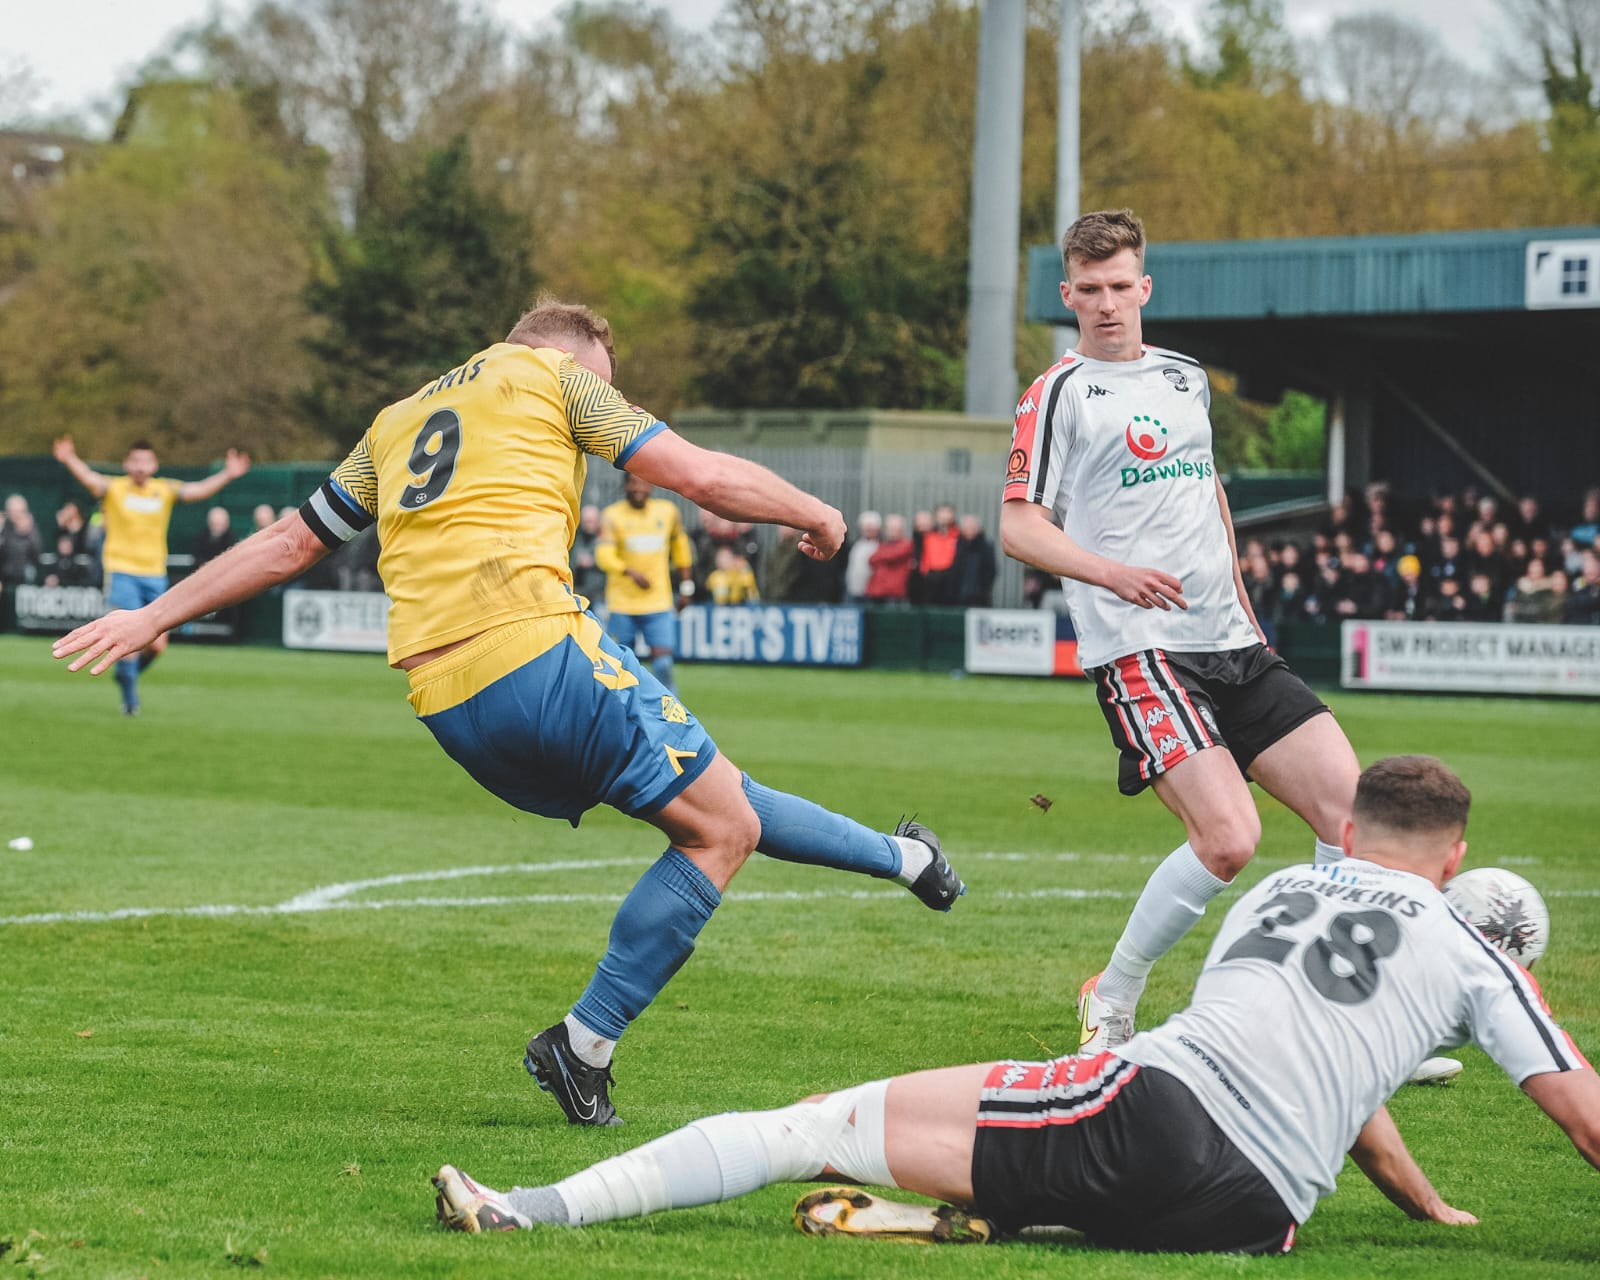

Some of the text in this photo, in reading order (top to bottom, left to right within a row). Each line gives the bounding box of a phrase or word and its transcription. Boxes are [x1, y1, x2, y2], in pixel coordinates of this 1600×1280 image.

[398, 407, 462, 511] 9
[1120, 459, 1212, 488] Dawleys
[789, 606, 833, 663] TV
[1413, 632, 1499, 657] PROJECT
[1268, 876, 1426, 918] HOWKINS
[1219, 891, 1400, 1004] 28
[1219, 1072, 1251, 1110] UNITED
